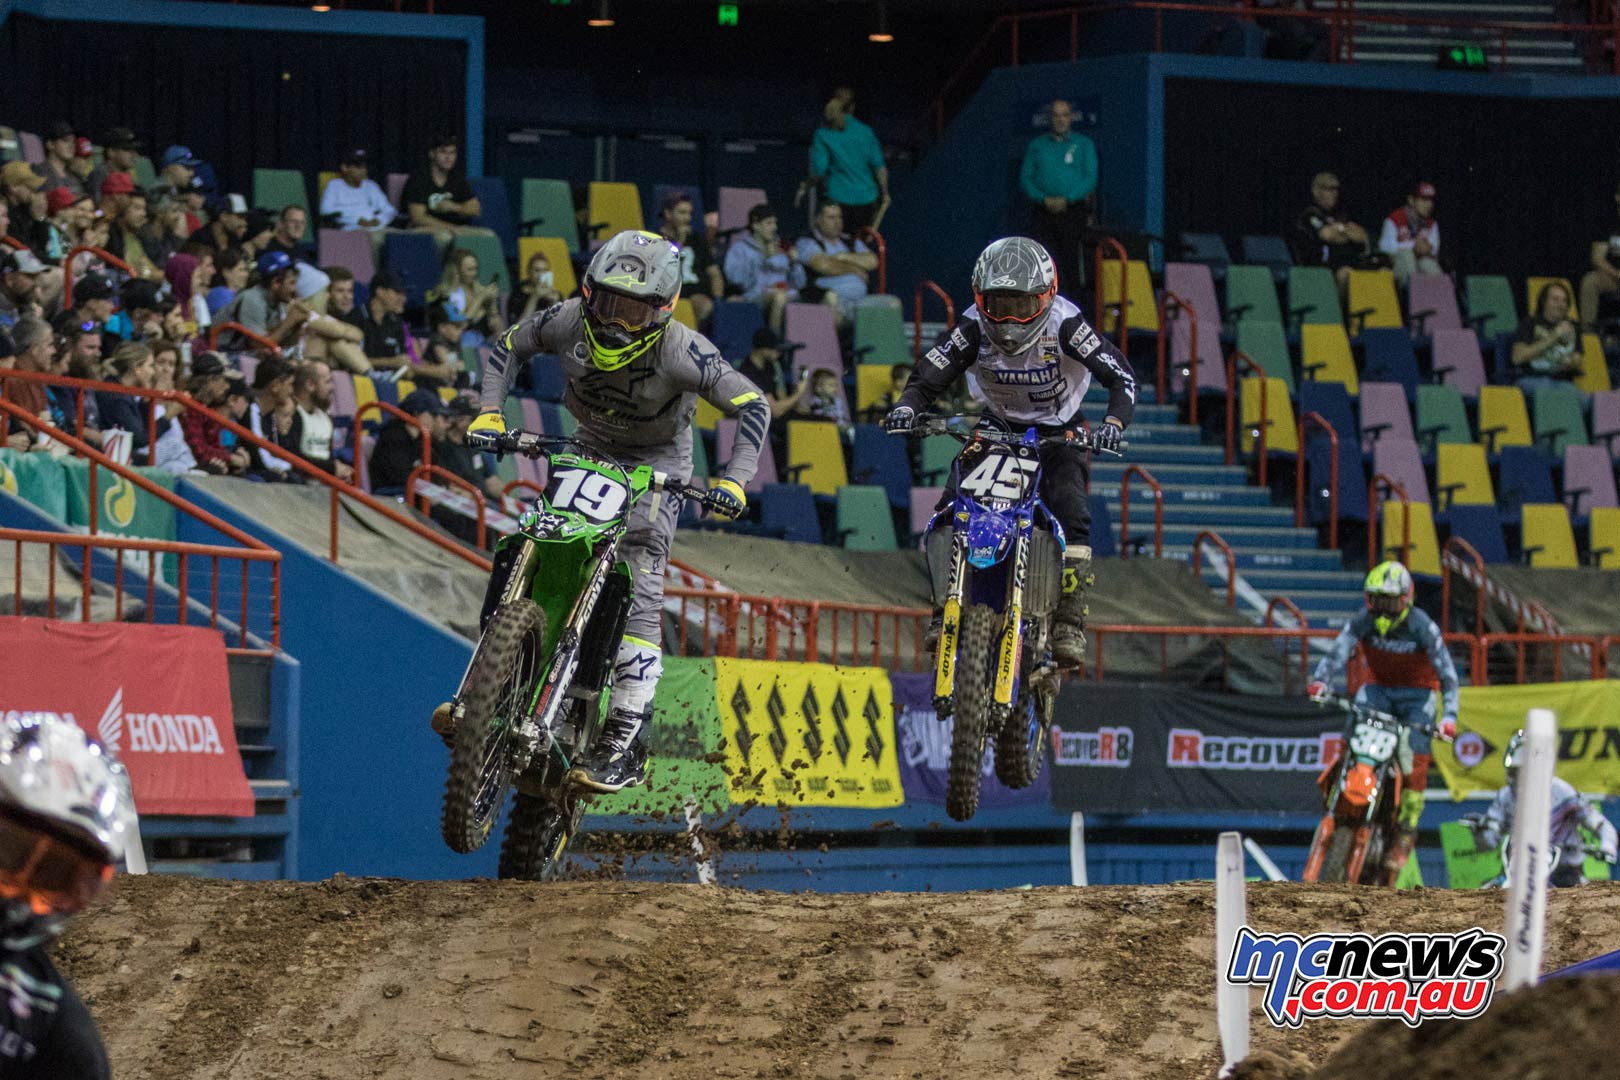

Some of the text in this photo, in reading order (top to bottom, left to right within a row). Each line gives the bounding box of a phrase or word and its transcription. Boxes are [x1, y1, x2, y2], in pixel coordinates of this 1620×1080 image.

[998, 366, 1060, 386] YAMAHA
[552, 469, 627, 521] 19
[960, 454, 1040, 499] 45
[942, 622, 956, 678] UNLOP
[125, 713, 224, 754] HONDA
